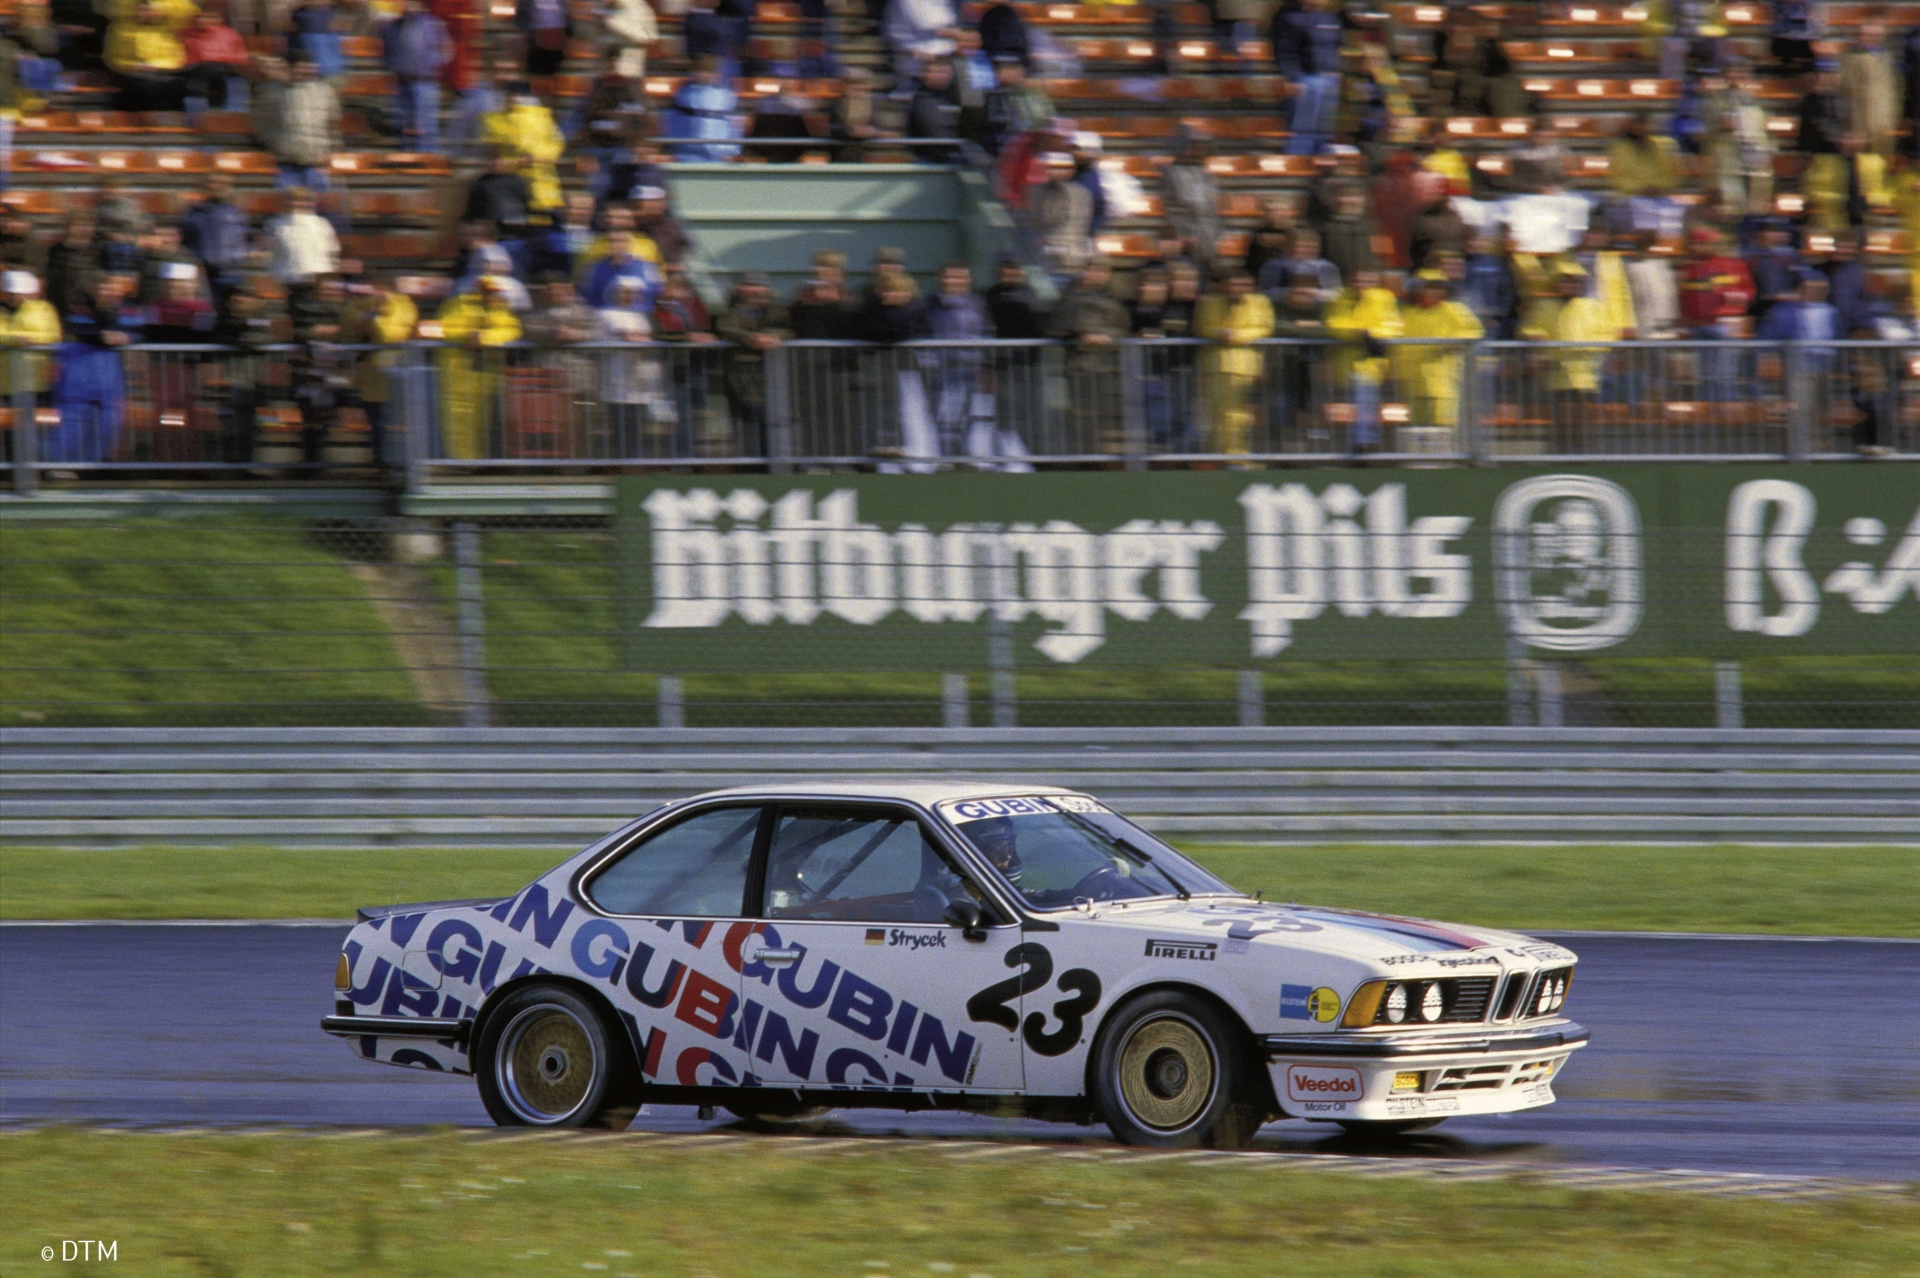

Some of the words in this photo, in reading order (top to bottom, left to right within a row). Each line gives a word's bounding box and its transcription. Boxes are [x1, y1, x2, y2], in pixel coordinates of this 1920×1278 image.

[1238, 483, 1474, 657] Pils
[954, 798, 1060, 819] GUBIN
[1203, 907, 1324, 940] 23
[889, 929, 946, 950] Strycek
[1144, 939, 1218, 961] PIRELLI
[571, 918, 820, 1081] GUBIN
[722, 921, 976, 1084] GUBIN
[966, 942, 1102, 1057] 23
[1294, 1075, 1356, 1092] Veedol
[1304, 1103, 1331, 1111] Motor
[1333, 1102, 1346, 1111] Oil
